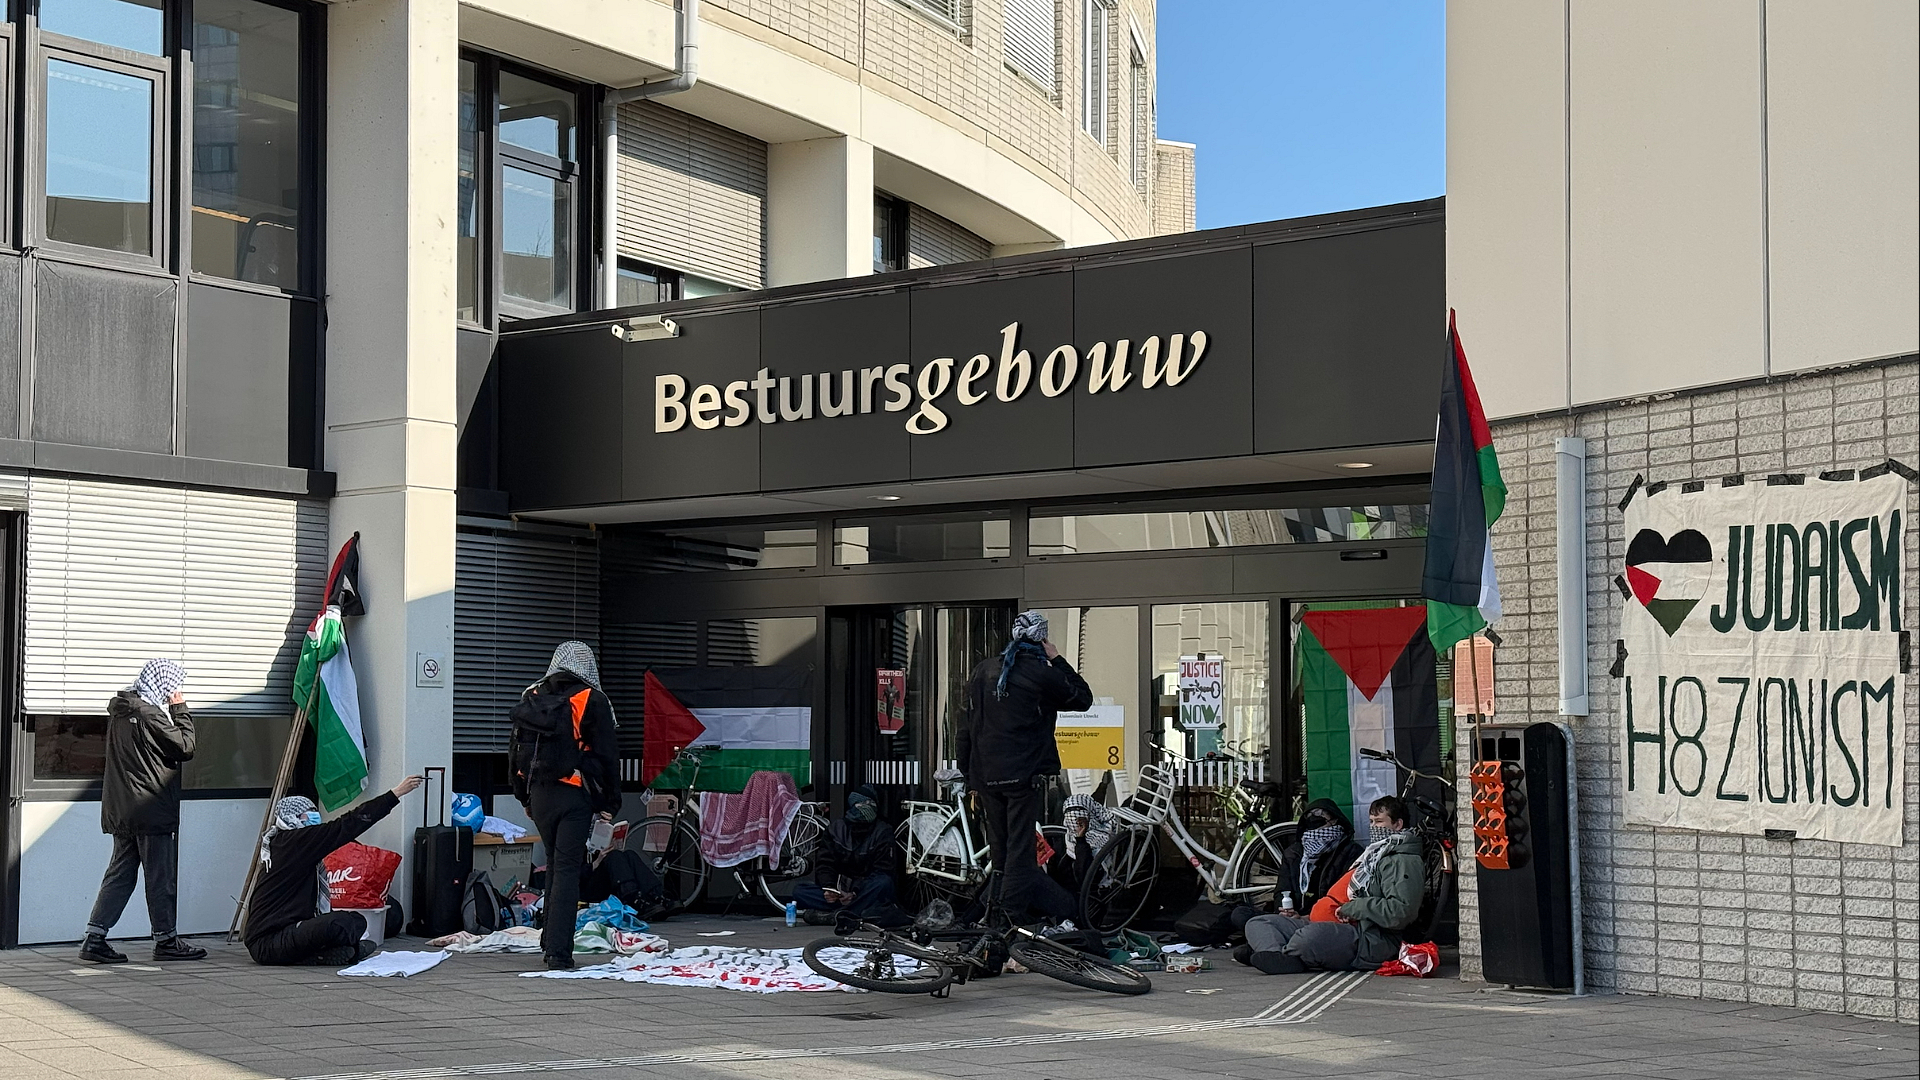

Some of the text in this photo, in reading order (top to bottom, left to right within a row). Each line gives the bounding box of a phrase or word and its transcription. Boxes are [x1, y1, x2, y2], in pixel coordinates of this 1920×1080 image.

[654, 322, 1209, 435] Bestuursgebouw
[1710, 508, 1902, 633] JUDAISM
[1181, 662, 1220, 678] JUSTICE
[1181, 704, 1220, 724] NOW
[1625, 674, 1894, 809] H8 ZIONISM
[1107, 746, 1119, 766] 8
